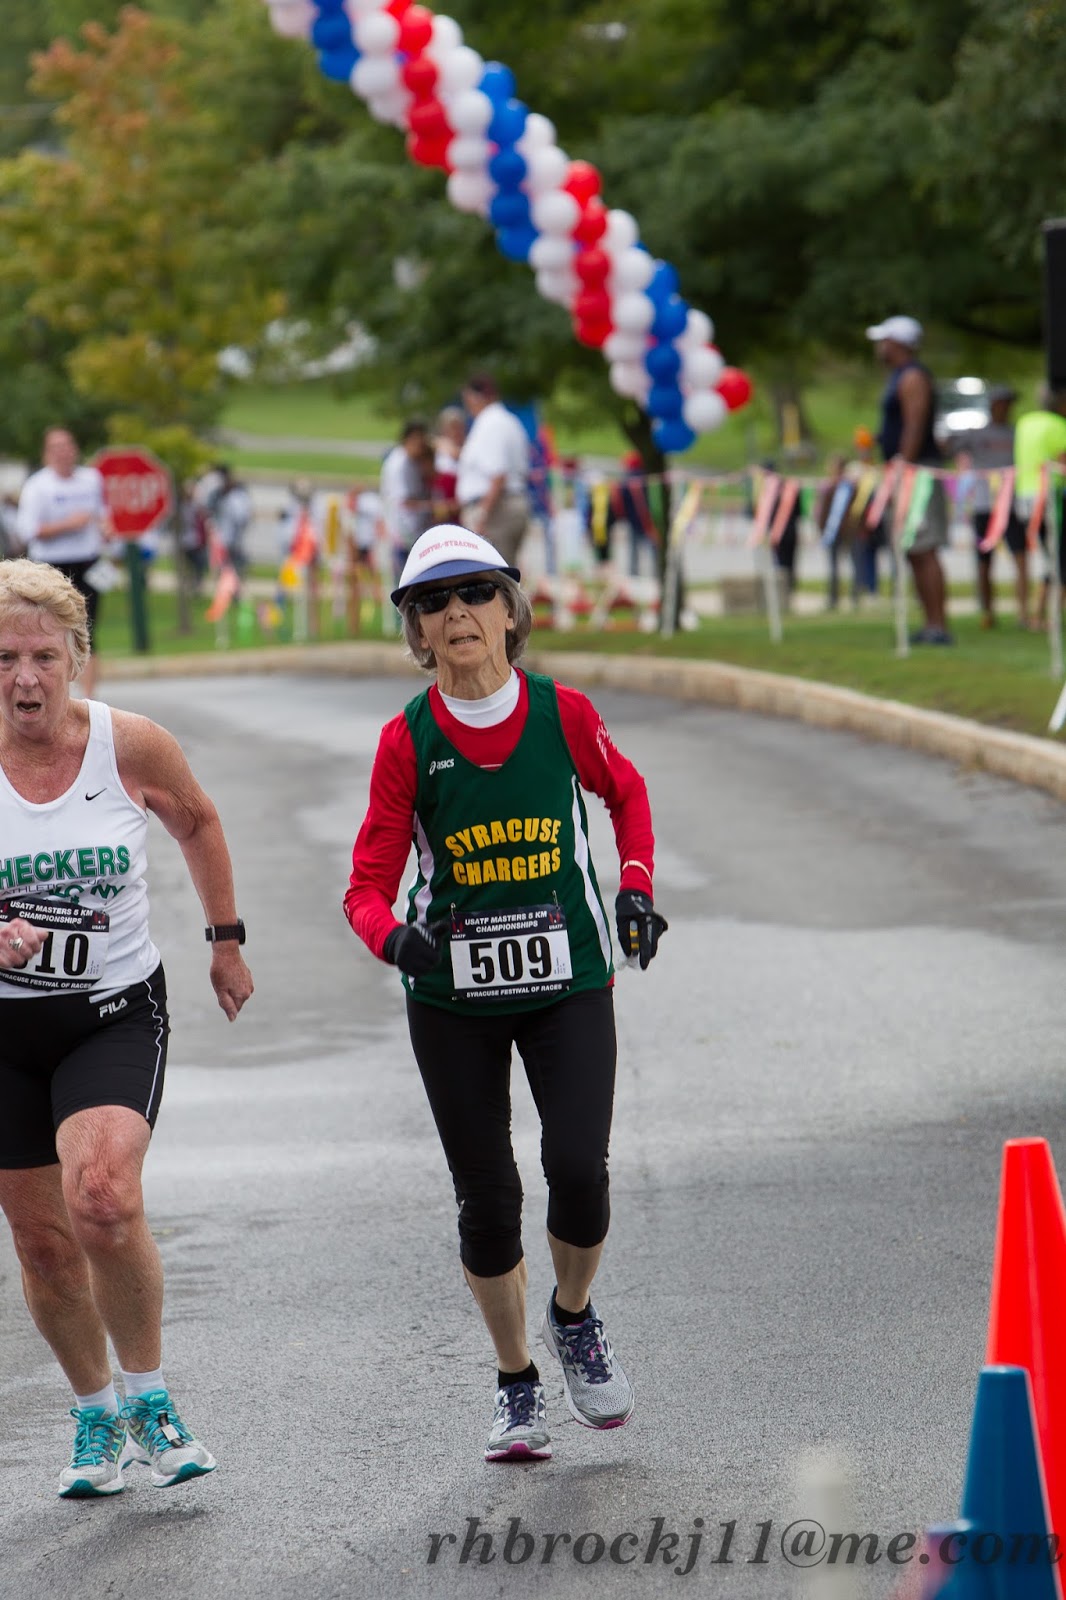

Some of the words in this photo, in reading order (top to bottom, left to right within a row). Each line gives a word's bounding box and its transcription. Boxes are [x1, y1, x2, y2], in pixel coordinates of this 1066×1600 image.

[104, 474, 160, 512] TOP
[445, 817, 562, 858] SYRACUSE
[453, 847, 561, 887] CHARGERS
[10, 901, 35, 911] USATF
[36, 905, 72, 916] MASTERS
[80, 909, 94, 917] KM
[19, 911, 83, 925] CHAMPIONSHIPS
[465, 917, 490, 926] USATF
[491, 913, 527, 924] MASTERS
[535, 911, 548, 919] KM
[476, 920, 539, 933] CHAMPIONSHIPS
[14, 931, 89, 976] 10
[469, 935, 552, 985] 509
[30, 978, 60, 988] FESTIVAL
[466, 988, 500, 998] SYRACUSE
[500, 987, 529, 995] FESTIVAL
[541, 983, 562, 992] RACES
[99, 997, 128, 1018] FILA
